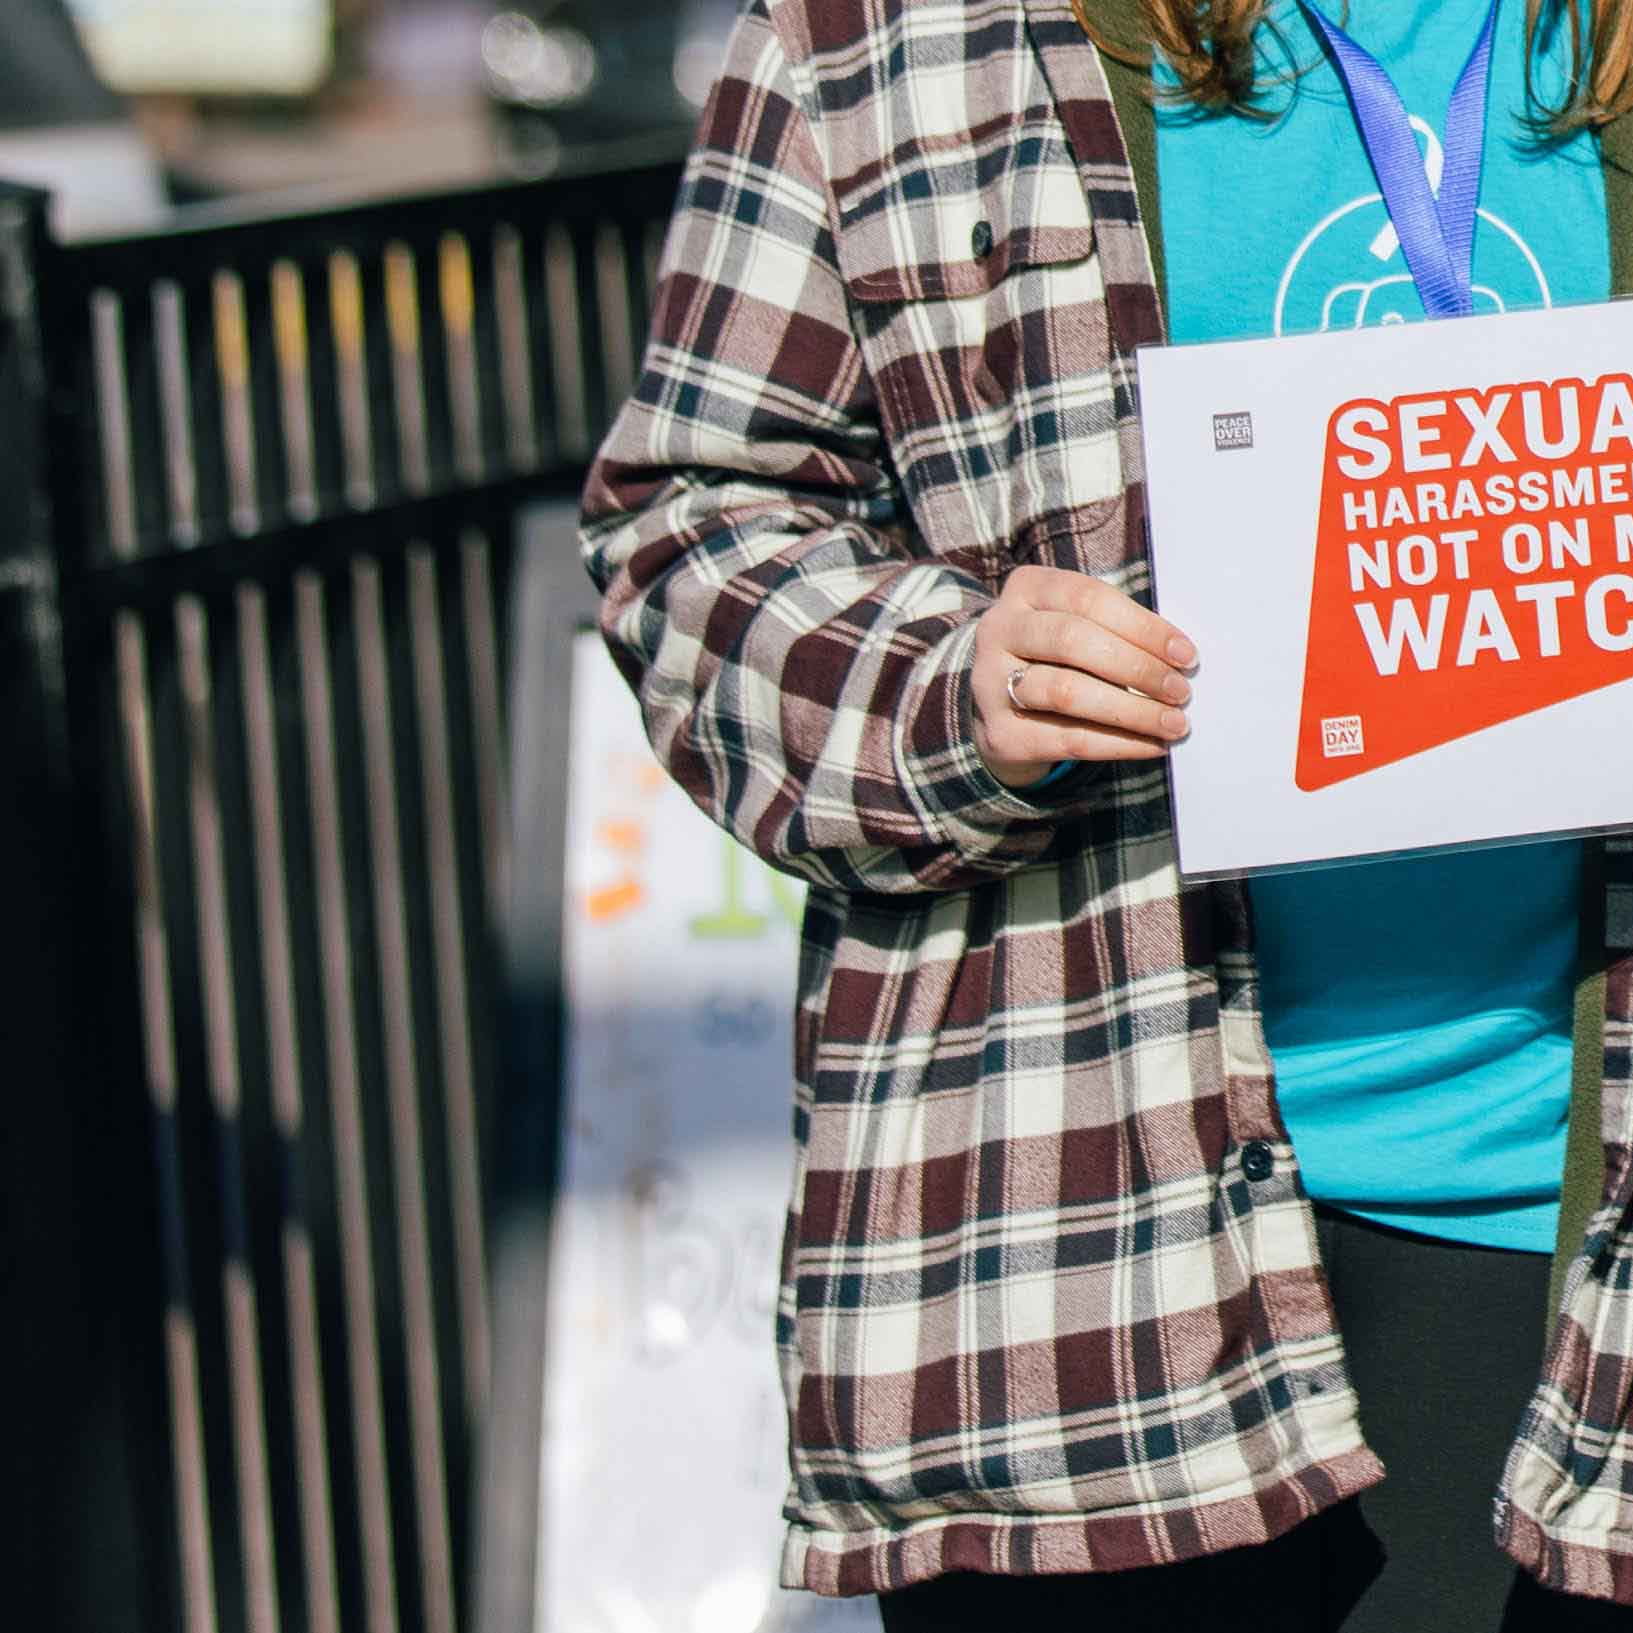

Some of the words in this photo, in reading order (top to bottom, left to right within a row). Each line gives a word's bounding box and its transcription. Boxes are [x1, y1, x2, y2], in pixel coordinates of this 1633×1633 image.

[1214, 416, 1250, 429] PEACE
[1215, 426, 1251, 440] OVER
[1346, 528, 1480, 593] NOT
[1502, 517, 1593, 575] ON
[1324, 719, 1359, 731] DENIM
[1326, 728, 1359, 746] DAY
